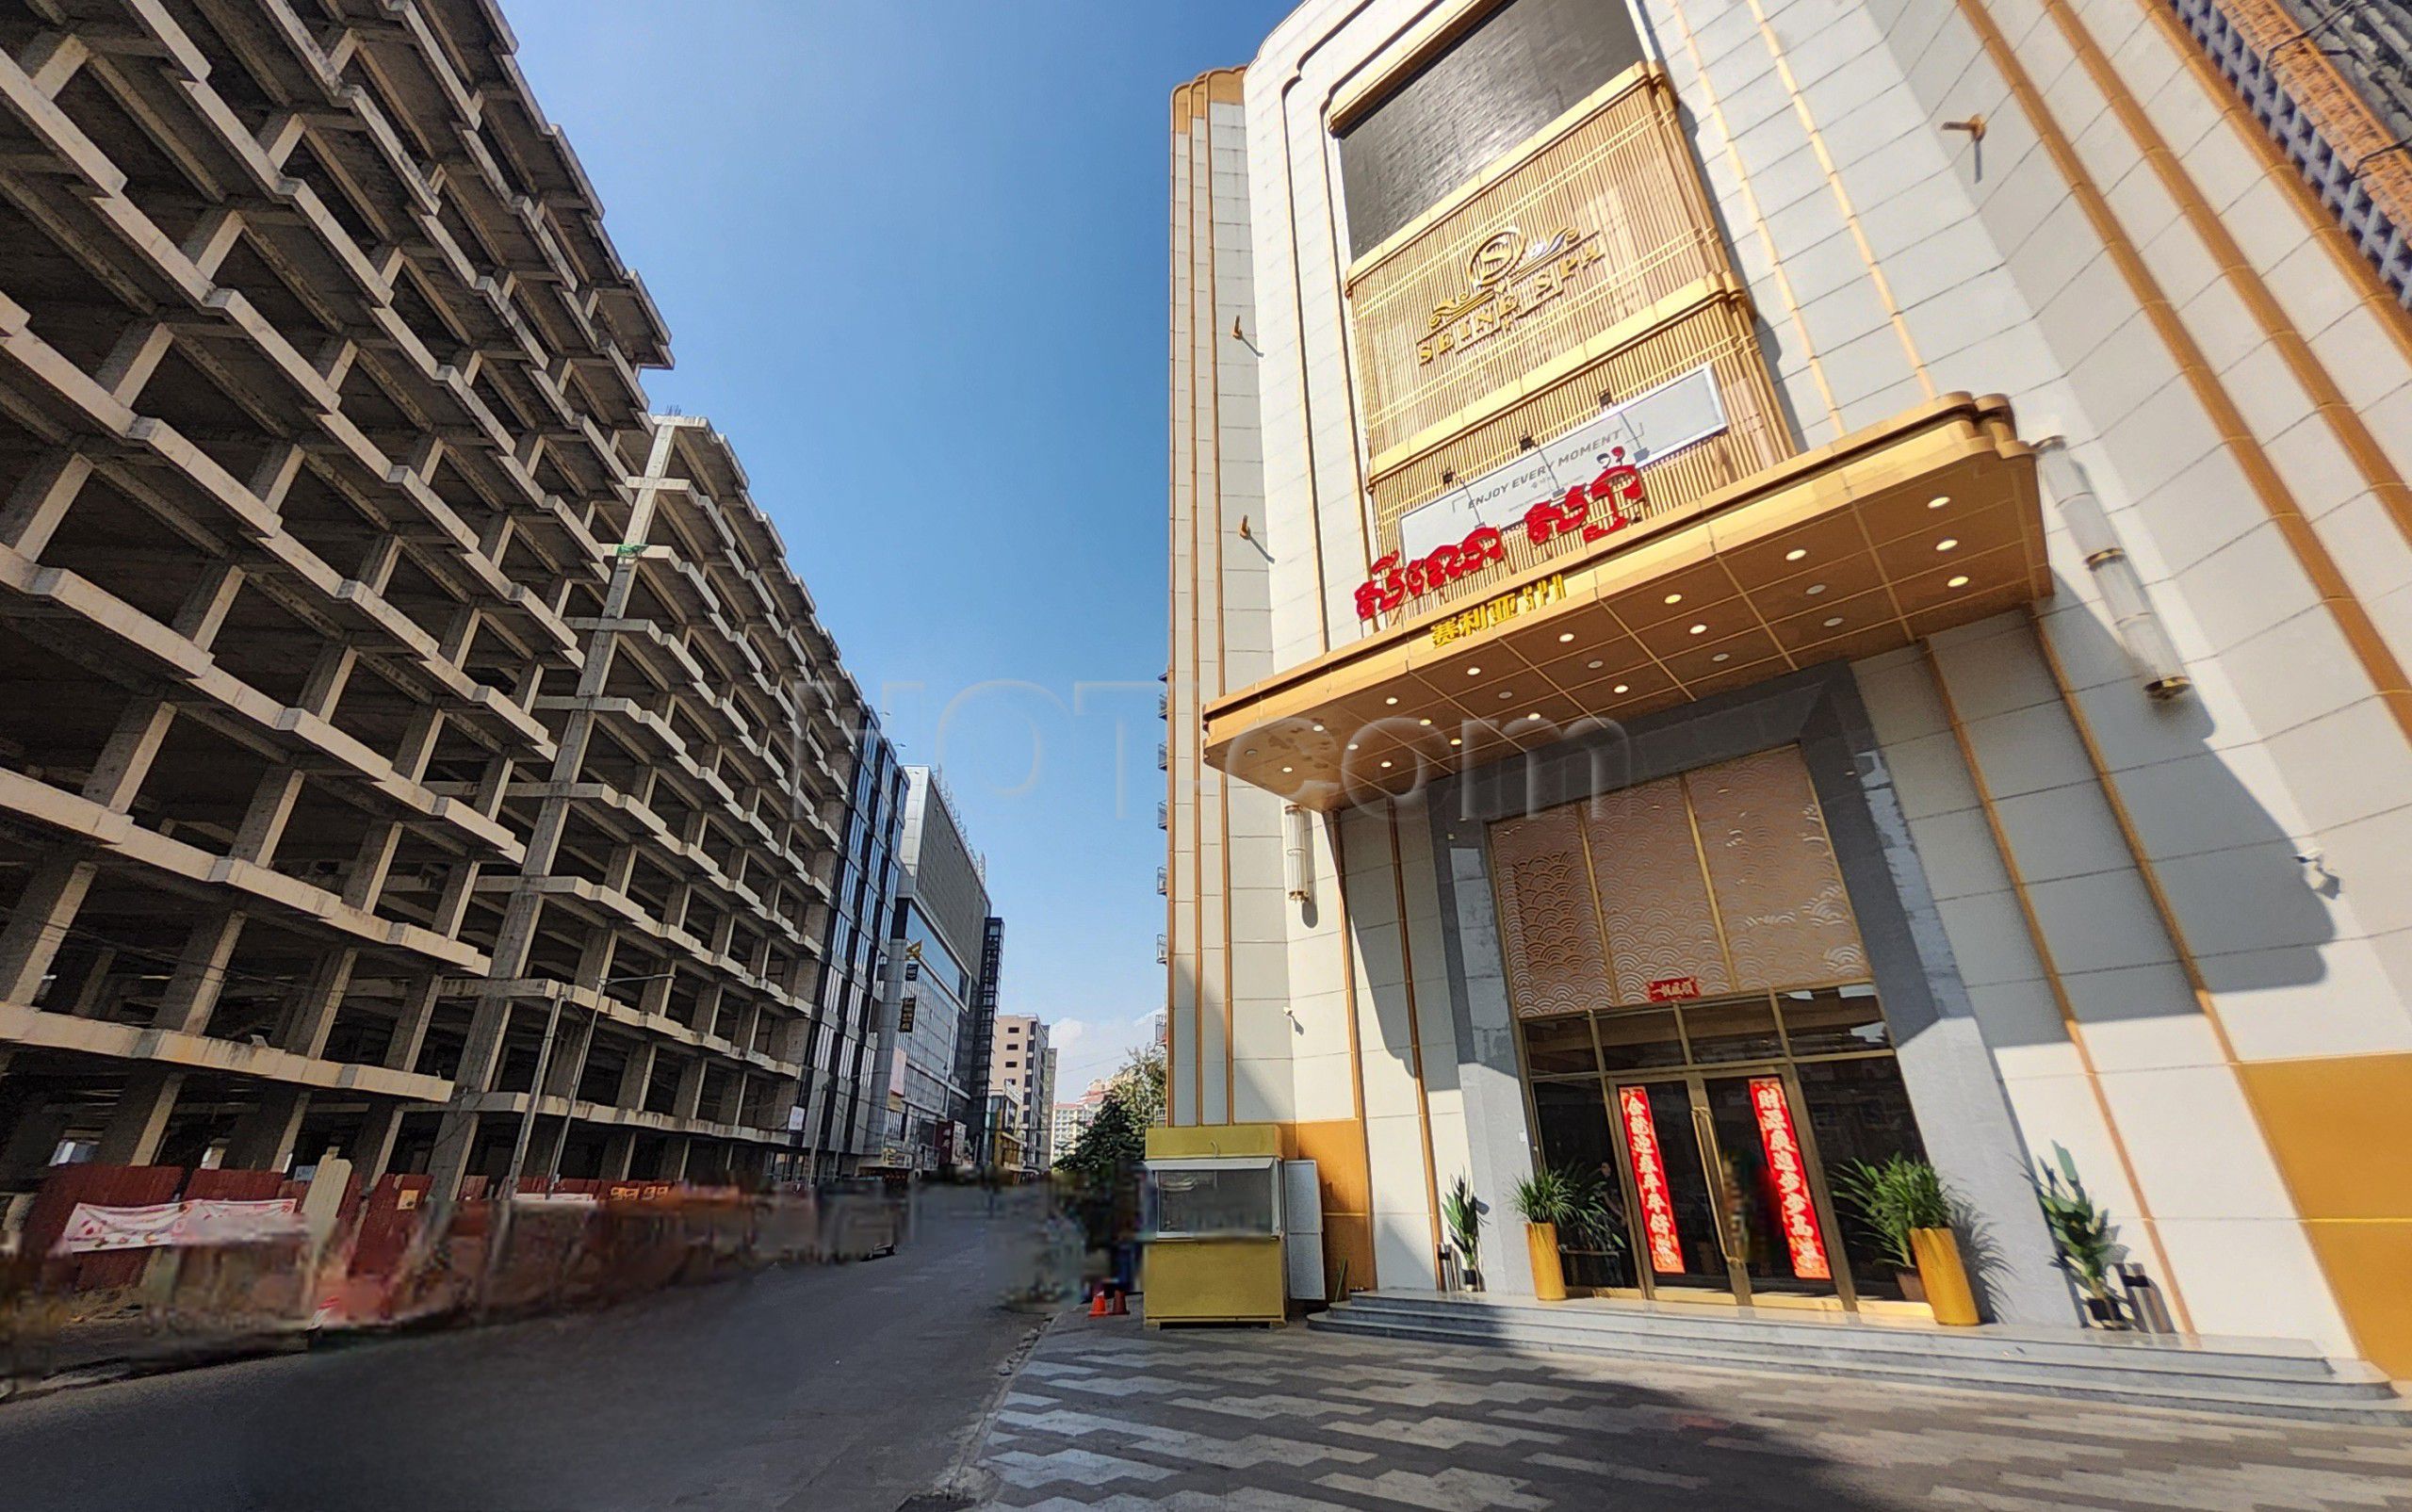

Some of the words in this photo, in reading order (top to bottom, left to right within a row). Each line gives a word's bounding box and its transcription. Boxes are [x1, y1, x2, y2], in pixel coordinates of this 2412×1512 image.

[1417, 294, 1518, 366] SEINE
[1533, 241, 1606, 298] SPA
[1468, 481, 1510, 510] ENJOY
[1512, 461, 1556, 488] EVERY
[1557, 428, 1624, 467] MOMENT
